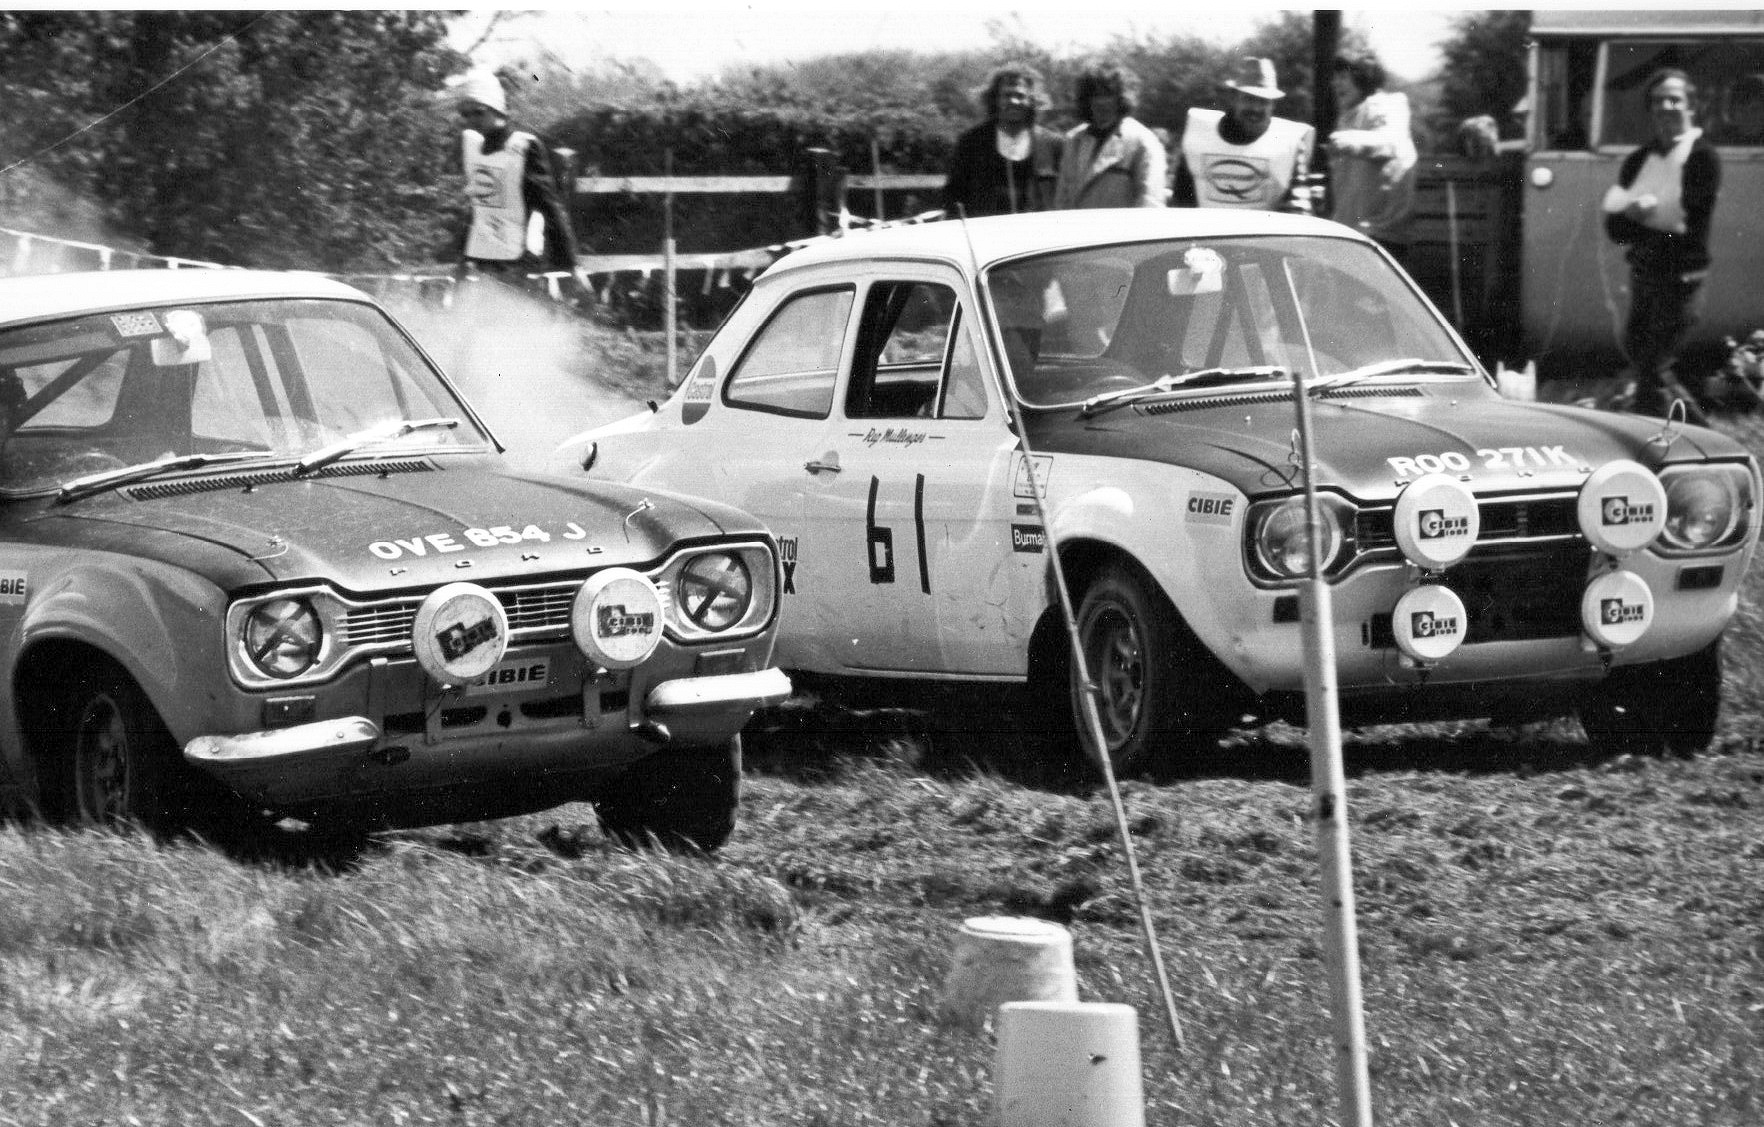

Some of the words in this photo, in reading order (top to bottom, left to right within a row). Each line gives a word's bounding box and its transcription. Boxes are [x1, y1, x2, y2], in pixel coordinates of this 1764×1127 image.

[1387, 451, 1471, 477] ROO
[1477, 445, 1579, 470] 271K
[1188, 497, 1234, 516] CIBIE
[368, 533, 465, 560] OVE
[463, 525, 551, 547] 854
[562, 522, 587, 540] J
[866, 473, 931, 595] 61
[776, 536, 798, 560] trol
[0, 577, 25, 595] BIE
[477, 664, 546, 686] IBIE
